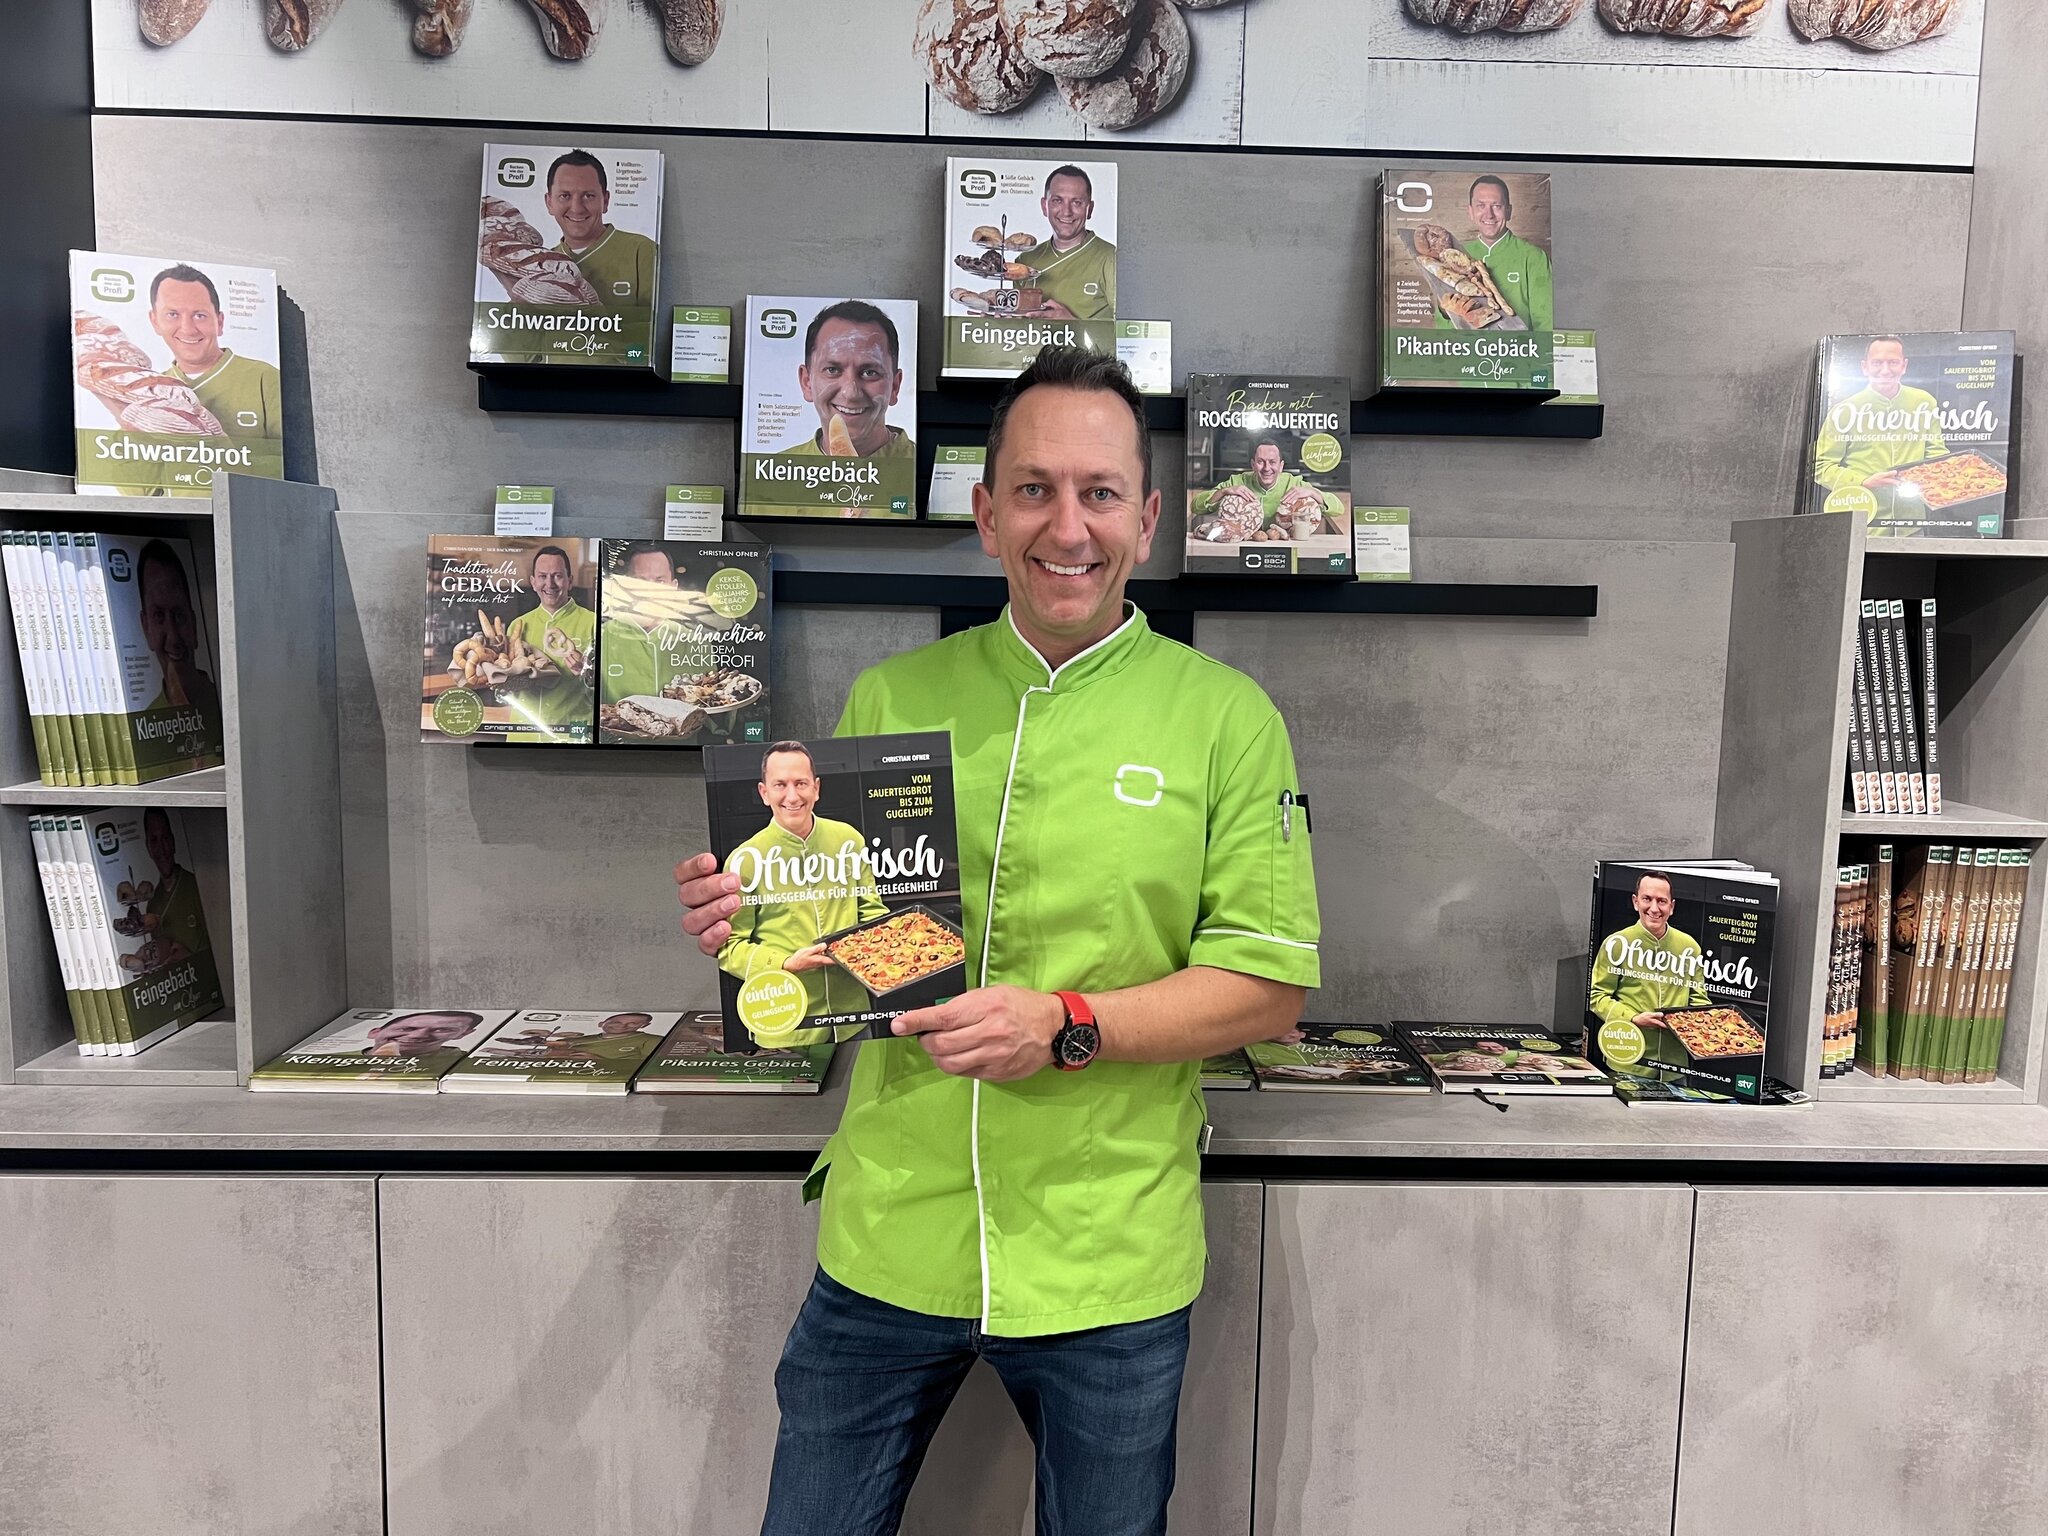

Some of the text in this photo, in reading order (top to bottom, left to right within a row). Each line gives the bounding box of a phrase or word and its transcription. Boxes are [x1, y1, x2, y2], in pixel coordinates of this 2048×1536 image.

[508, 173, 524, 181] Profi
[104, 286, 122, 294] Profi
[487, 308, 622, 333] Schwarzbrot
[553, 334, 609, 356] vom Ofner
[961, 322, 1076, 351] Feingebäck
[628, 350, 641, 358] stv
[1397, 336, 1539, 358] Pikantes Gebäck
[1462, 358, 1514, 379] vom Ofner
[1533, 374, 1546, 382] stv
[1227, 390, 1324, 414] Backen mit
[1200, 411, 1338, 430] ROGGESAUERTEIG
[1832, 401, 1998, 433] Ofnerfrisch
[1834, 432, 1992, 442] LIEBLINGSGEBÄCK FÜR JEDE GELEGENHEIT
[95, 436, 252, 466] Schwarzbrot
[1306, 444, 1338, 462] einfach
[175, 474, 194, 486] vom
[755, 459, 880, 489] Kleingebäck
[819, 485, 874, 507] vom Ofner
[1831, 494, 1870, 507] einfach
[1979, 520, 1996, 529] stv
[442, 559, 517, 576] Traditionelles
[1331, 558, 1344, 566] stv
[442, 575, 525, 593] GEBÄCK
[441, 594, 514, 607] auf dreierlei Art
[658, 623, 766, 651] Weihnachten
[690, 645, 735, 655] MIT DEM
[671, 654, 754, 668] BACKPROFI
[1868, 628, 1880, 691] ROGGENSAUERTEIG
[1882, 628, 1895, 691] ROGGENSAUERTEIG
[1926, 628, 1935, 691] ROGGENSAUERTEIG
[1896, 629, 1917, 762] OFNER BACKEN MIT ROGGENSAUERTEIG
[135, 710, 205, 743] Kleingebäck
[1862, 706, 1870, 732] BACKEN
[1877, 707, 1885, 733] BACKEN
[1891, 707, 1900, 733] BACKEN
[1928, 708, 1936, 734] BACKEN
[571, 726, 584, 734] stv
[747, 727, 760, 736] stv
[882, 755, 911, 763] CHRISTIAN
[1851, 739, 1859, 761] OFNER
[1865, 739, 1874, 761] OFNER
[1880, 740, 1889, 761] OFNER
[1894, 740, 1903, 762] OFNER
[912, 775, 931, 784] VOM
[868, 785, 932, 798] SAUERTEIGBROT
[900, 797, 932, 807] BIS ZUM
[886, 807, 933, 819] GUGELHUPF
[729, 834, 944, 893] Ofnerfrisch
[828, 886, 847, 899] FÜR
[850, 886, 873, 897] JEDE
[876, 880, 939, 896] GELEGENHEIT
[1709, 915, 1757, 929] SAUERTEIGBROT
[1742, 912, 1757, 920] VOM
[1719, 933, 1756, 944] GUGELHUPF
[1605, 934, 1759, 990] Ofnerfrisch
[1833, 947, 1842, 982] GEBÄCK
[132, 962, 198, 1010] Feingebäck
[746, 979, 796, 1003] einfach
[1607, 966, 1752, 999] LIEBLINGSGEBÄCK FÜR JEDE GELEGENHEIT
[752, 1003, 796, 1019] GELINGSICHER
[1411, 1030, 1548, 1039] ROGGENSAUERTEIG
[1604, 1027, 1639, 1040] einfach
[1298, 1044, 1400, 1053] Weihnachten
[285, 1055, 420, 1067] Kleingebäck
[473, 1057, 597, 1070] Feingebäck
[659, 1058, 812, 1069] Pikantes Gebäck
[1738, 1080, 1753, 1089] stv
